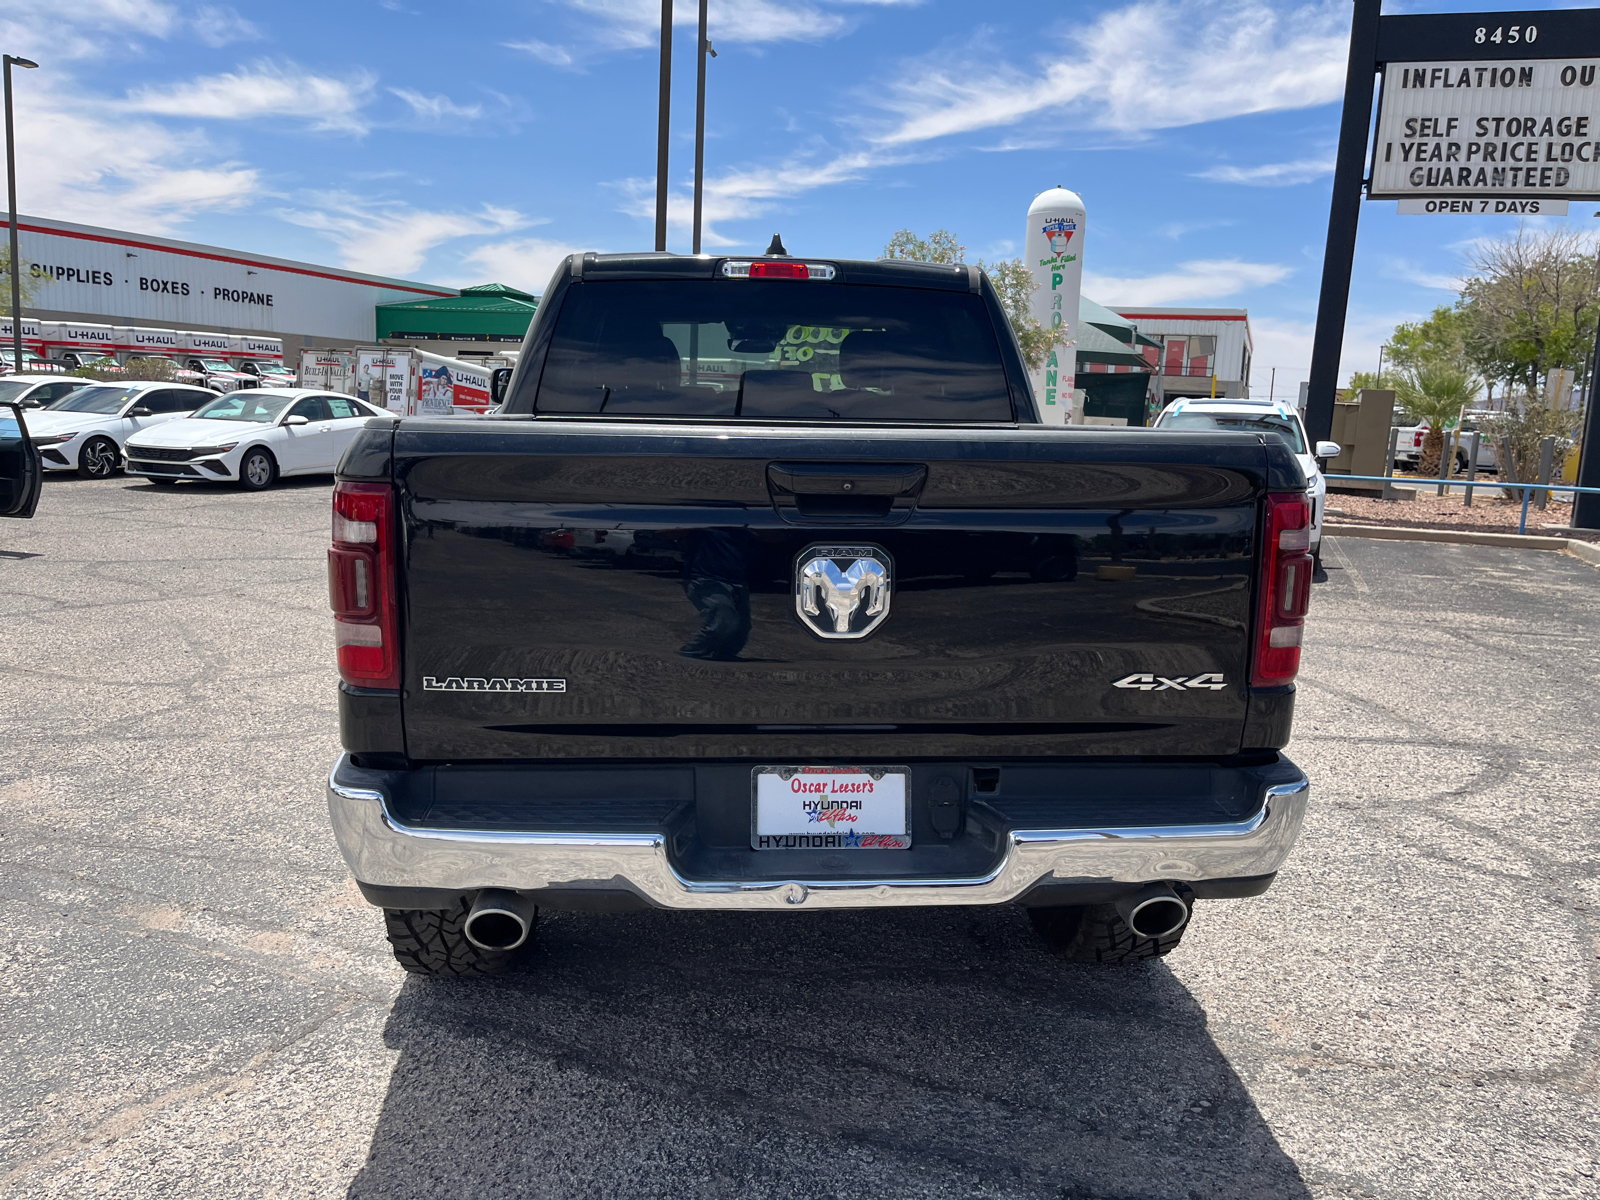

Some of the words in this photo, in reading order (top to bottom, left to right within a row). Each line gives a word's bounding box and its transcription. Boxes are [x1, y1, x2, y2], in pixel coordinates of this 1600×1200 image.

[1474, 26, 1538, 44] 8450
[1402, 67, 1533, 88] INFLATION
[1404, 118, 1459, 138] SELF
[1475, 117, 1589, 137] STORAGE
[1400, 142, 1461, 162] YEAR
[1466, 142, 1538, 162] PRICE
[1409, 167, 1570, 187] GUARANTEED
[1425, 201, 1473, 213] OPEN
[1479, 201, 1490, 212] 7
[1495, 201, 1540, 213] DAYS
[1039, 256, 1058, 266] Tanks
[1061, 253, 1077, 263] Filled
[30, 263, 113, 286] SUPPLIES
[140, 277, 190, 296] BOXES
[214, 287, 274, 307] PROPANE
[68, 330, 112, 341] U-HAUL
[136, 335, 176, 345] U-HAUL
[1046, 273, 1063, 405] PROANE
[193, 339, 228, 349] U-HAUL
[248, 342, 281, 353] U-HAUL
[456, 372, 487, 388] U-HAUL
[423, 677, 566, 692] LARAMIE
[791, 778, 828, 793] Oscar
[830, 779, 874, 793] Leeser's
[803, 800, 862, 810] HYUNDAI
[819, 809, 833, 822] El
[832, 807, 858, 822] Paso
[759, 836, 841, 848] HYUNDAI
[861, 835, 879, 847] El
[880, 835, 904, 848] Paso
